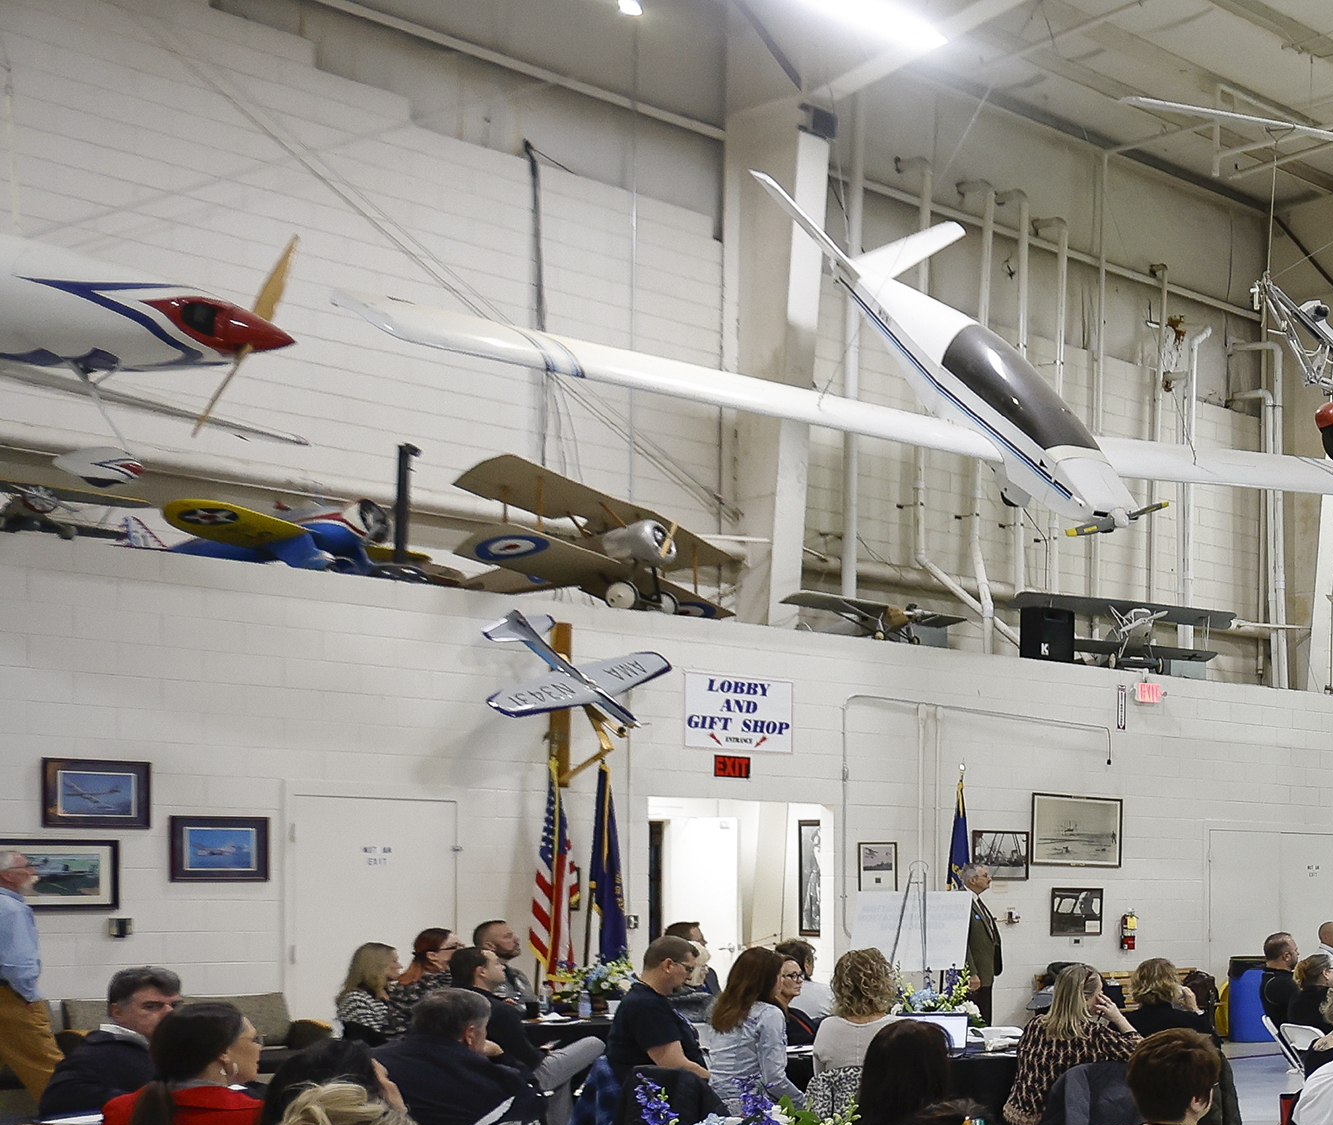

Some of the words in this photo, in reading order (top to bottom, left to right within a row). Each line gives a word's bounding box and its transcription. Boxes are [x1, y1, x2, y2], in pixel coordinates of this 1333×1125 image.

[706, 678, 770, 697] LOBBY
[1140, 684, 1160, 702] EXIT
[719, 698, 758, 714] AND
[687, 714, 733, 731] GIFT
[741, 718, 790, 735] SHOP
[715, 756, 749, 777] EXIT
